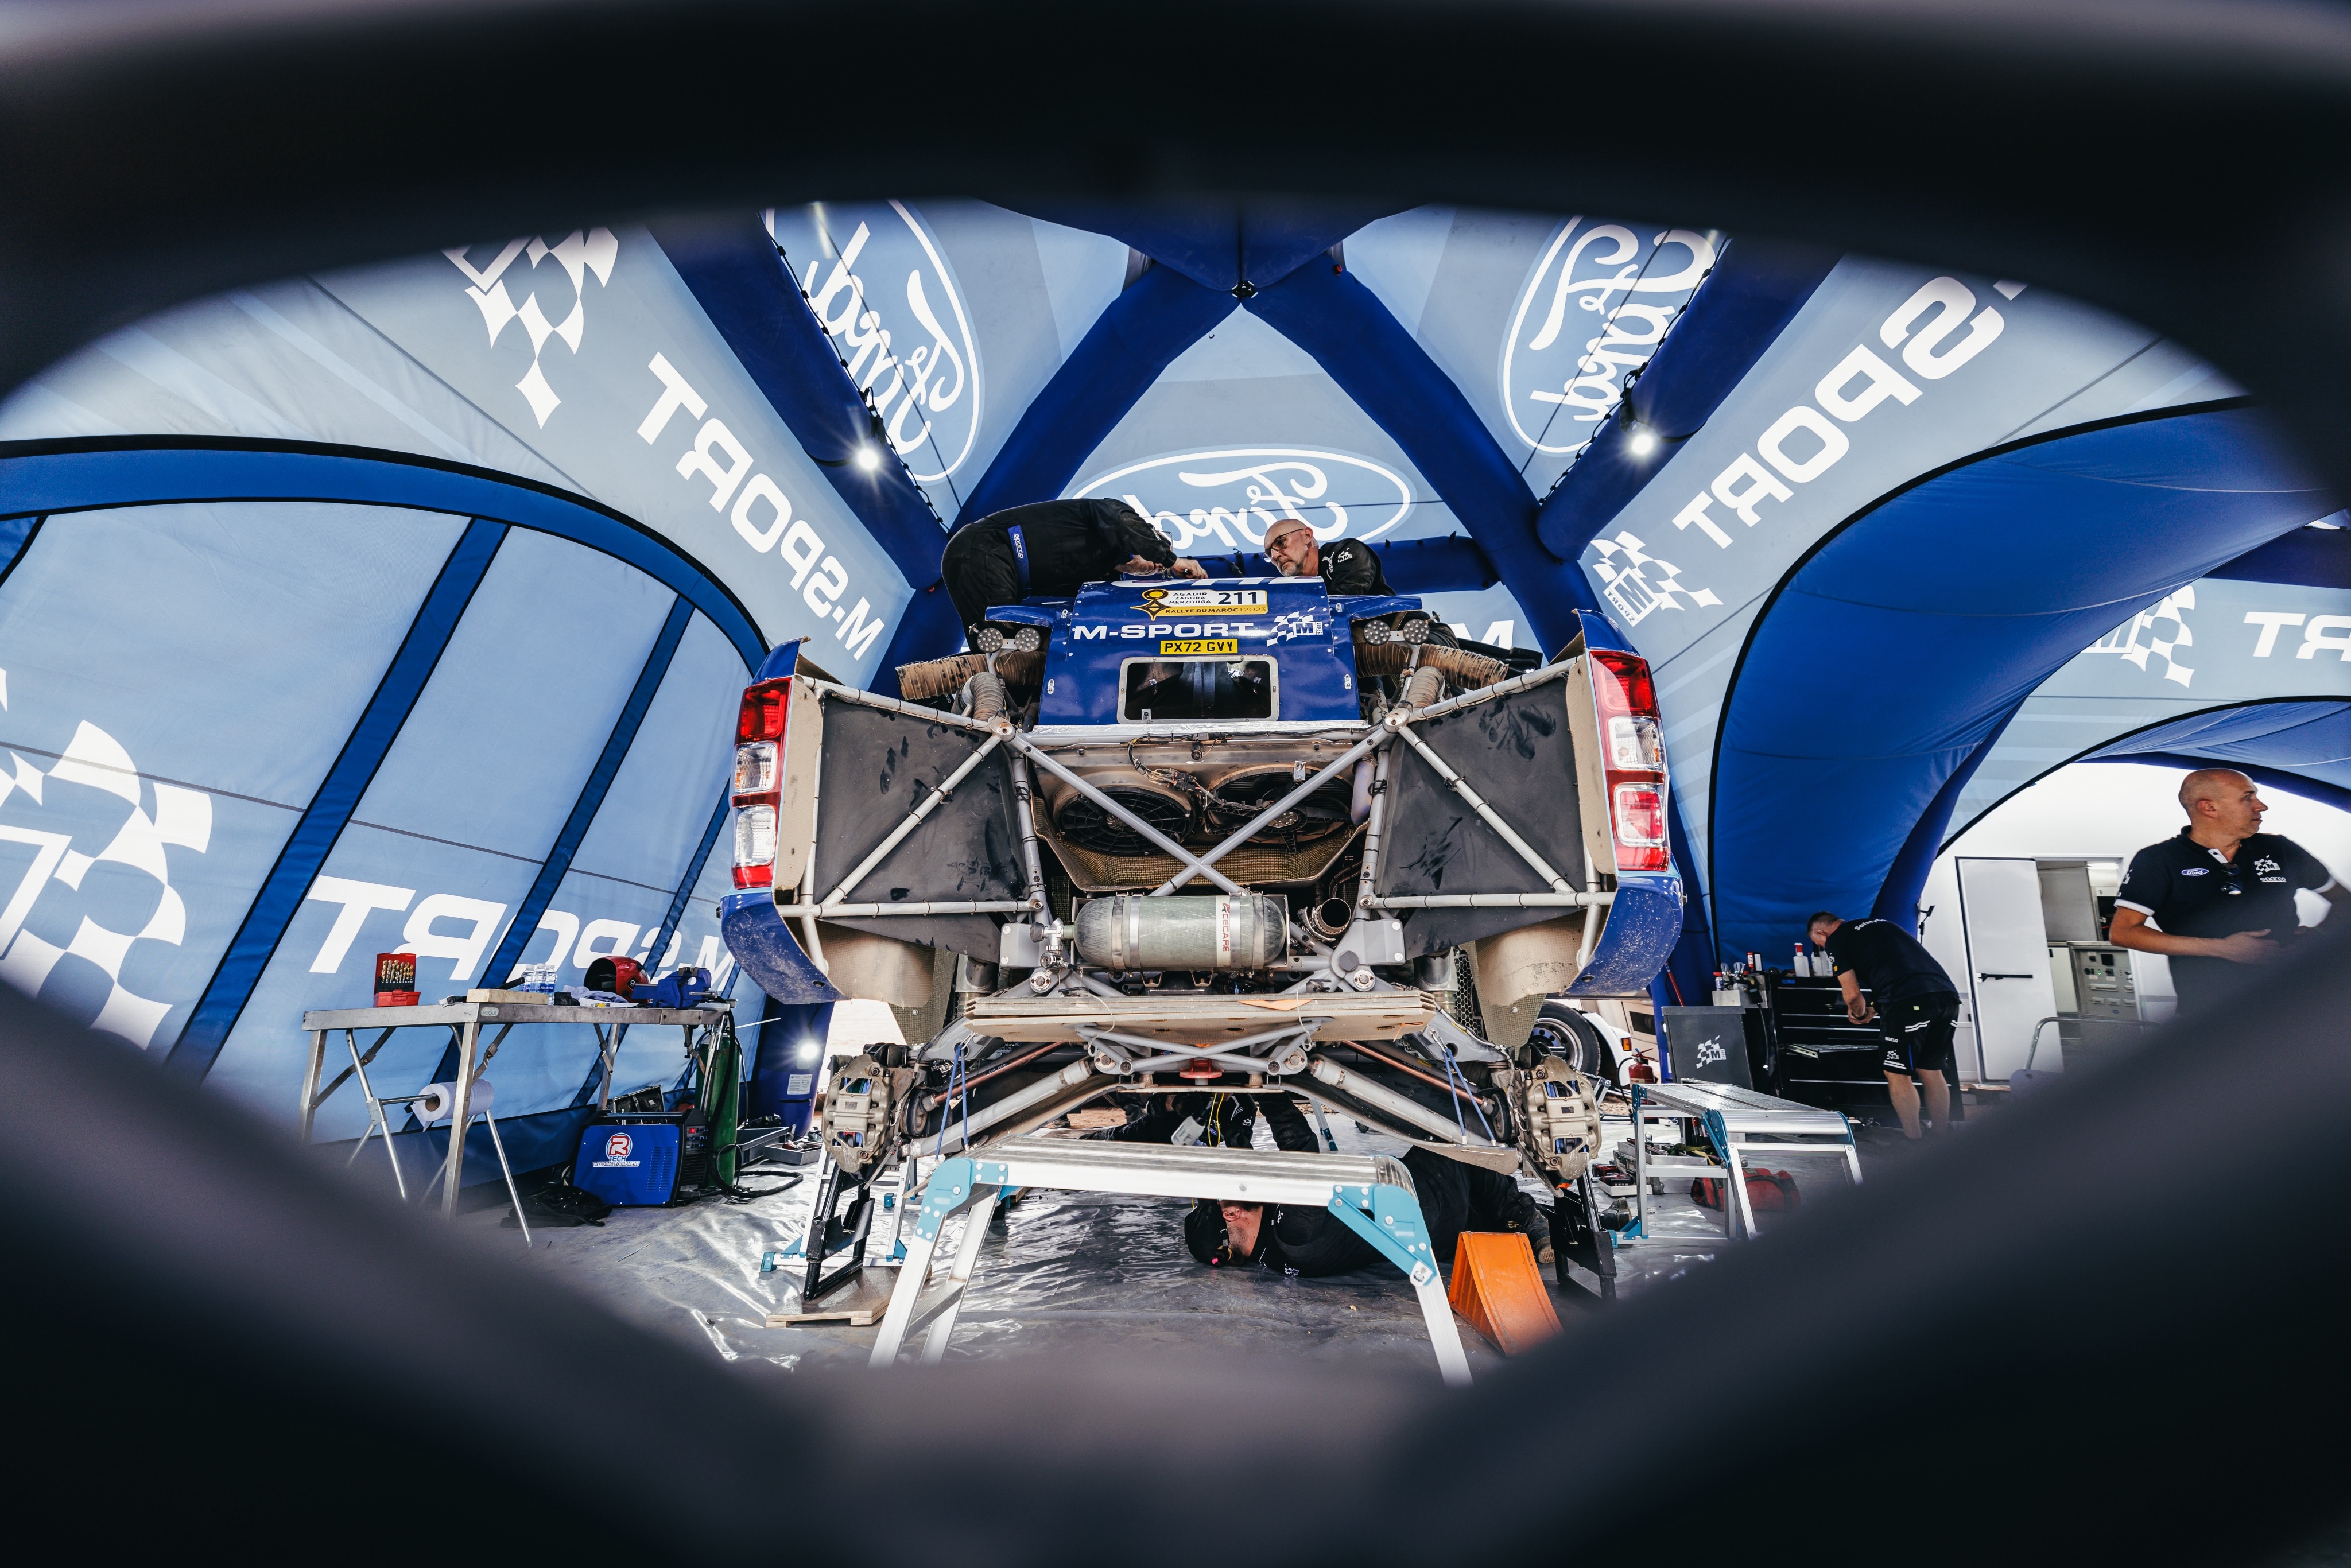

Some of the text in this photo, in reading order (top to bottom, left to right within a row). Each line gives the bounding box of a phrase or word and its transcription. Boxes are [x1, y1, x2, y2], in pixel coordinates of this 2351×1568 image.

[1013, 533, 1023, 558] sparco
[1218, 592, 1257, 604] 211
[1074, 623, 1254, 640] M-SPORT
[1295, 623, 1314, 634] M
[1165, 641, 1233, 653] PX72 GVY
[609, 1136, 629, 1156] R
